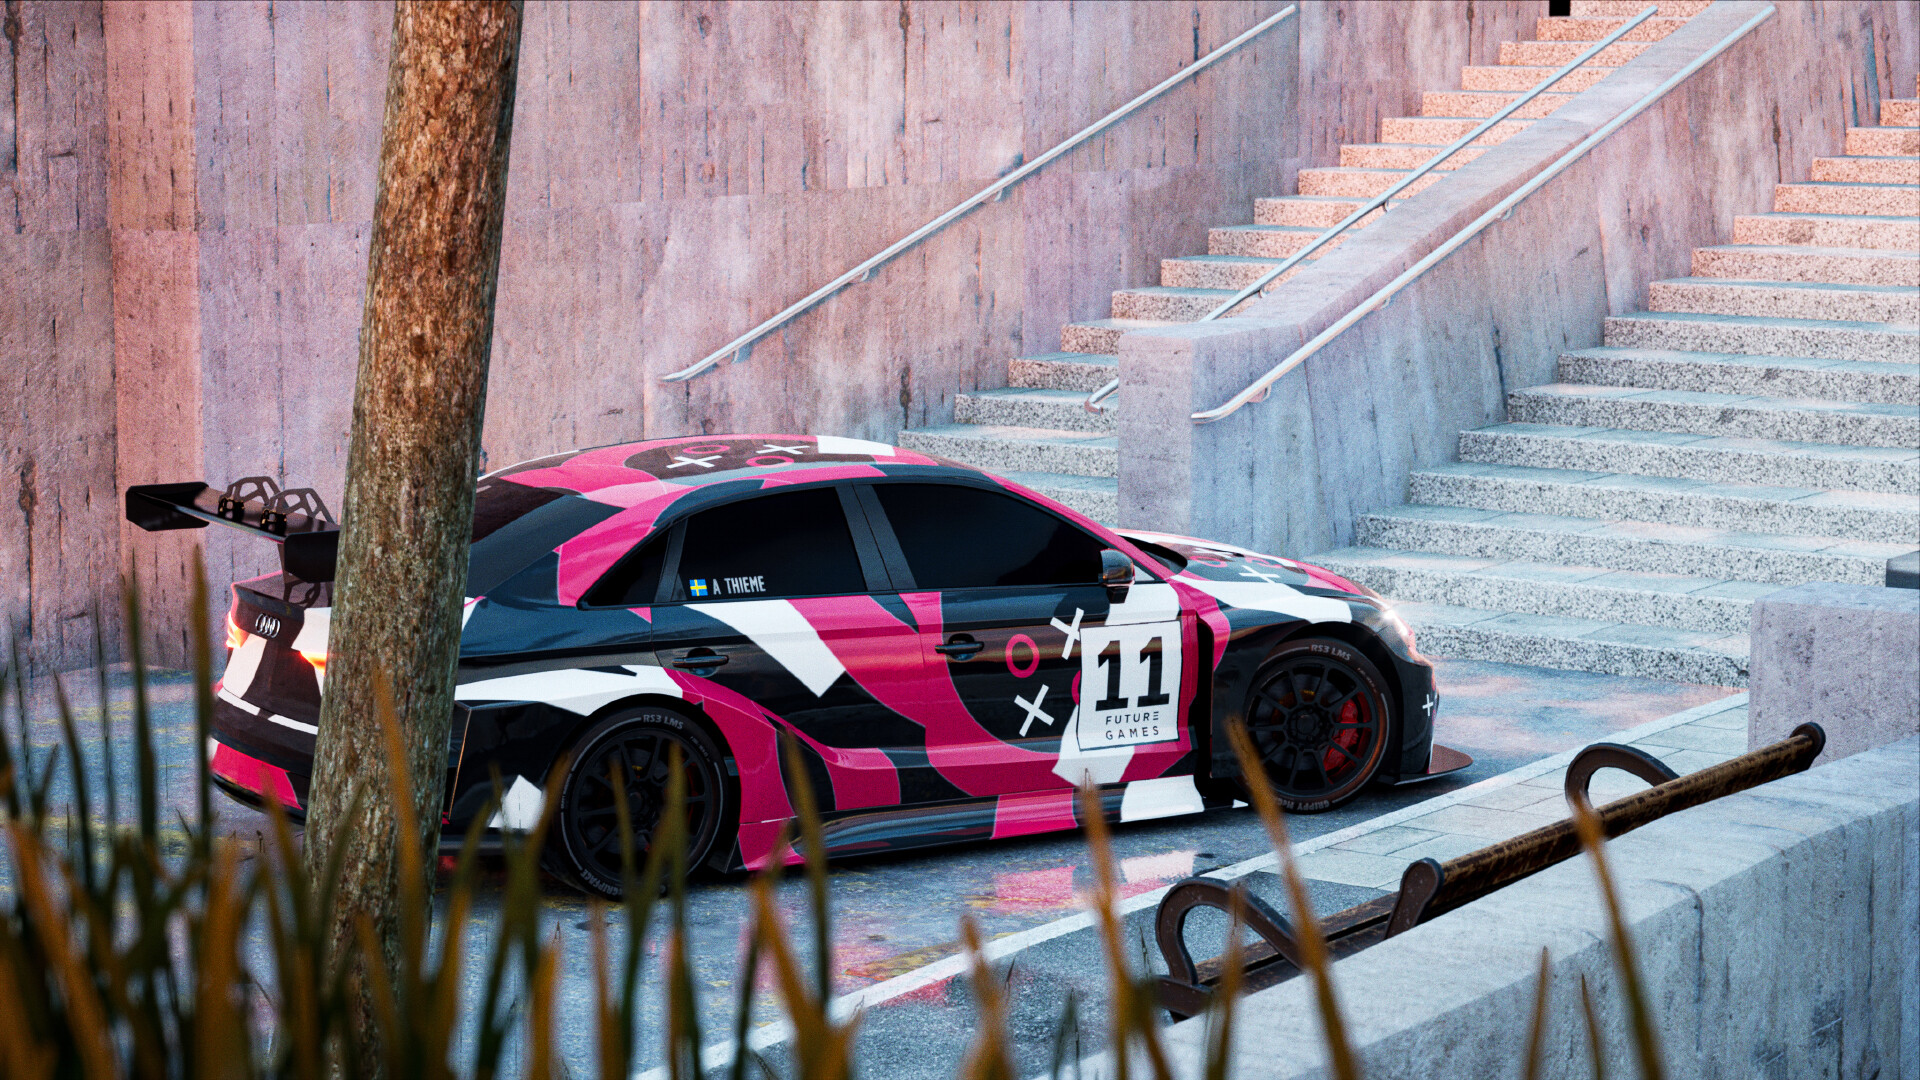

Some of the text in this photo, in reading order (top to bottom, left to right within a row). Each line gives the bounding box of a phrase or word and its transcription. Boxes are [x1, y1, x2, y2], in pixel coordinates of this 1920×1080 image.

[712, 575, 767, 596] A THIEME
[1311, 644, 1352, 661] RS3 LMS
[1095, 636, 1170, 711] 11
[643, 714, 684, 730] RS3 LMS
[1105, 711, 1160, 726] FUTURE
[1105, 726, 1159, 740] GAMES
[1297, 799, 1331, 811] GRIPPY
